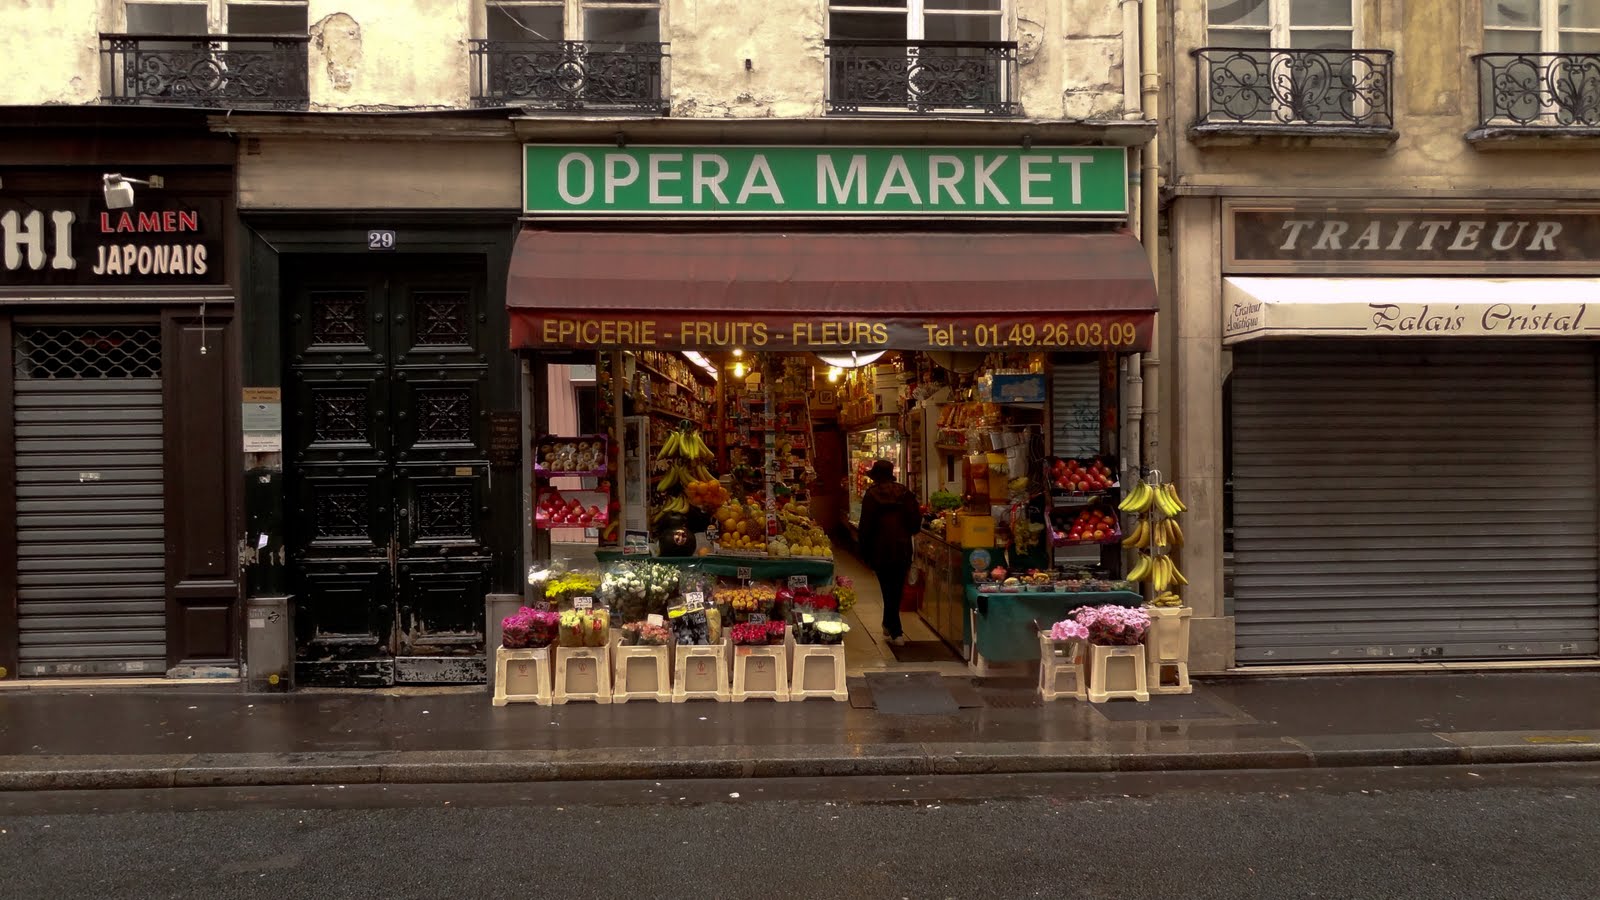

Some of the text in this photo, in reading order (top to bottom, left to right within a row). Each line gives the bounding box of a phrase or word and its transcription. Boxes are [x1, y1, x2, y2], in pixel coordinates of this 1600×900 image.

[557, 153, 1095, 206] OPERA MARKET
[100, 210, 199, 233] LAMEN
[370, 232, 393, 248] 29
[1279, 220, 1563, 252] TRAITEUR
[93, 243, 208, 276] JAPONAIS
[1233, 302, 1262, 317] Traiteur
[1368, 303, 1586, 331] Palais Cristal
[542, 319, 656, 345] EPICERIE
[681, 321, 768, 346] FRUITS
[792, 321, 889, 346] FLEURS
[922, 323, 954, 347] Tel
[974, 322, 1136, 346] 01.49.26.03.09
